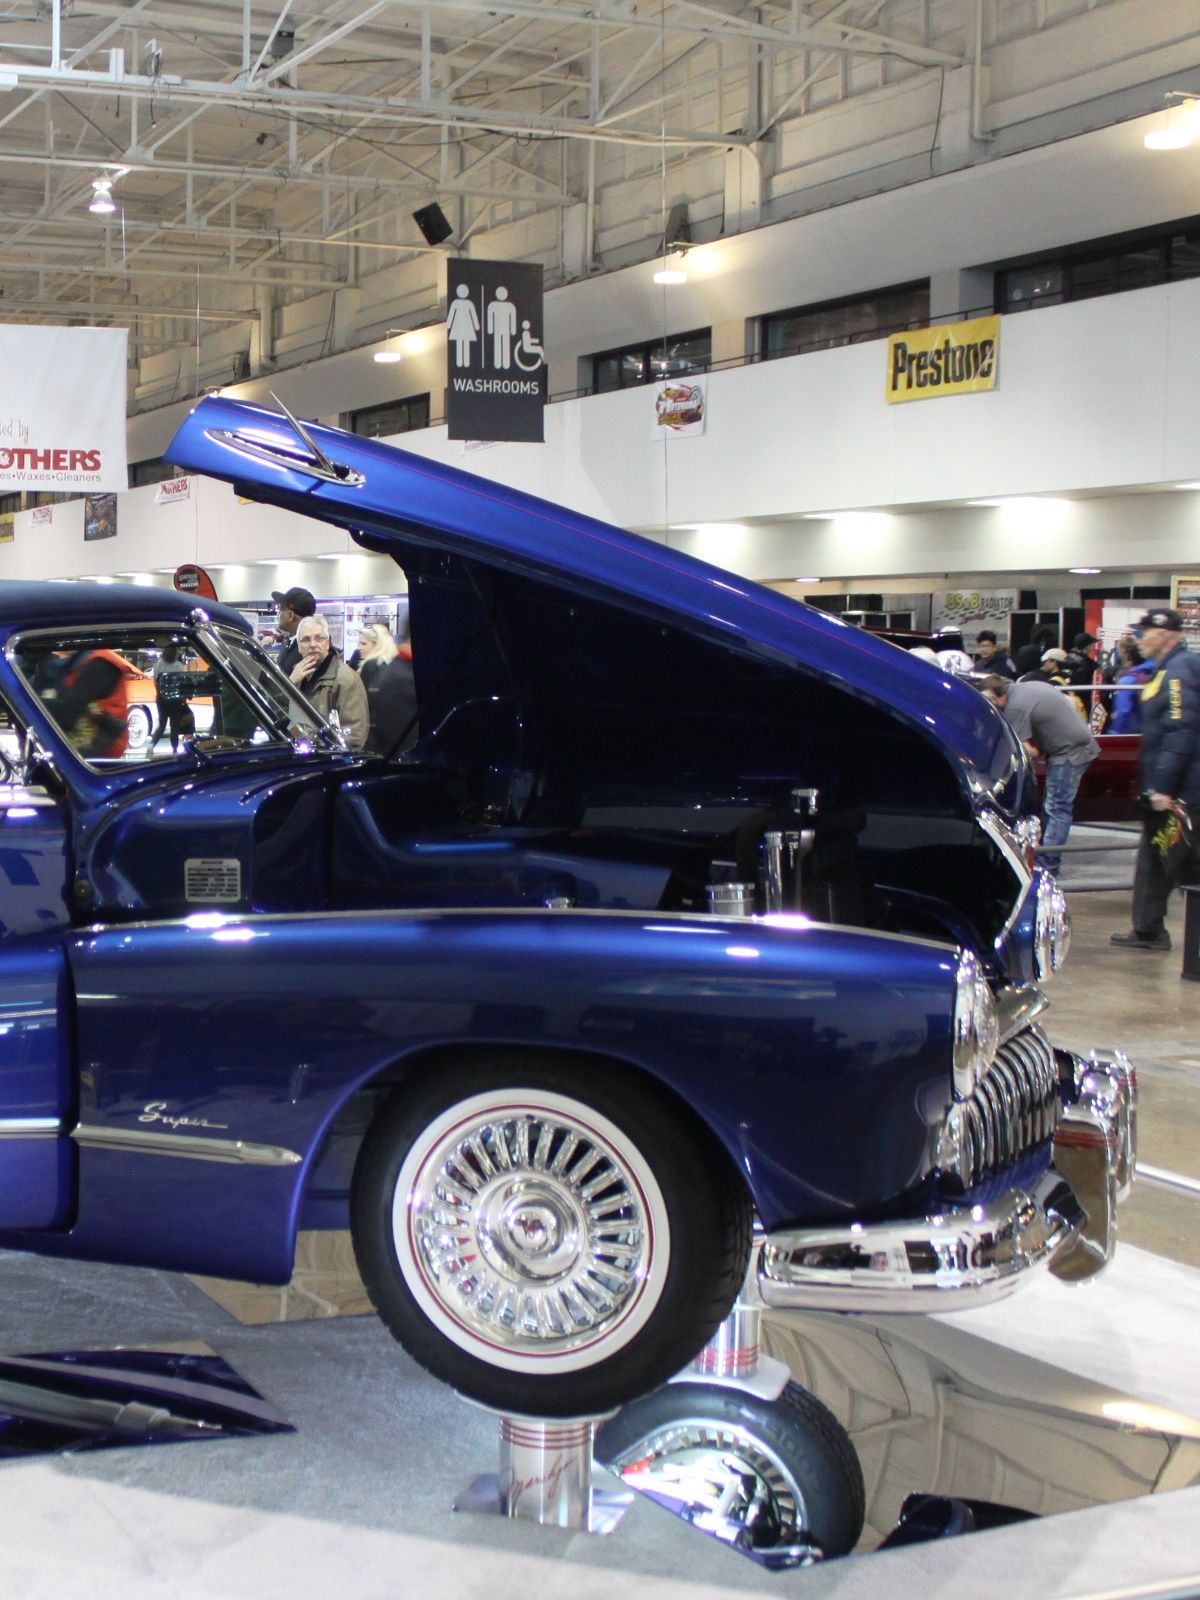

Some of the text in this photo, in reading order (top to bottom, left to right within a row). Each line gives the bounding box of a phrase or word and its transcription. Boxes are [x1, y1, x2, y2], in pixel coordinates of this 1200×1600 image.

[892, 338, 995, 391] Prestone
[453, 378, 539, 395] WASHROOMS
[18, 419, 29, 444] by
[138, 1102, 228, 1129] Super
